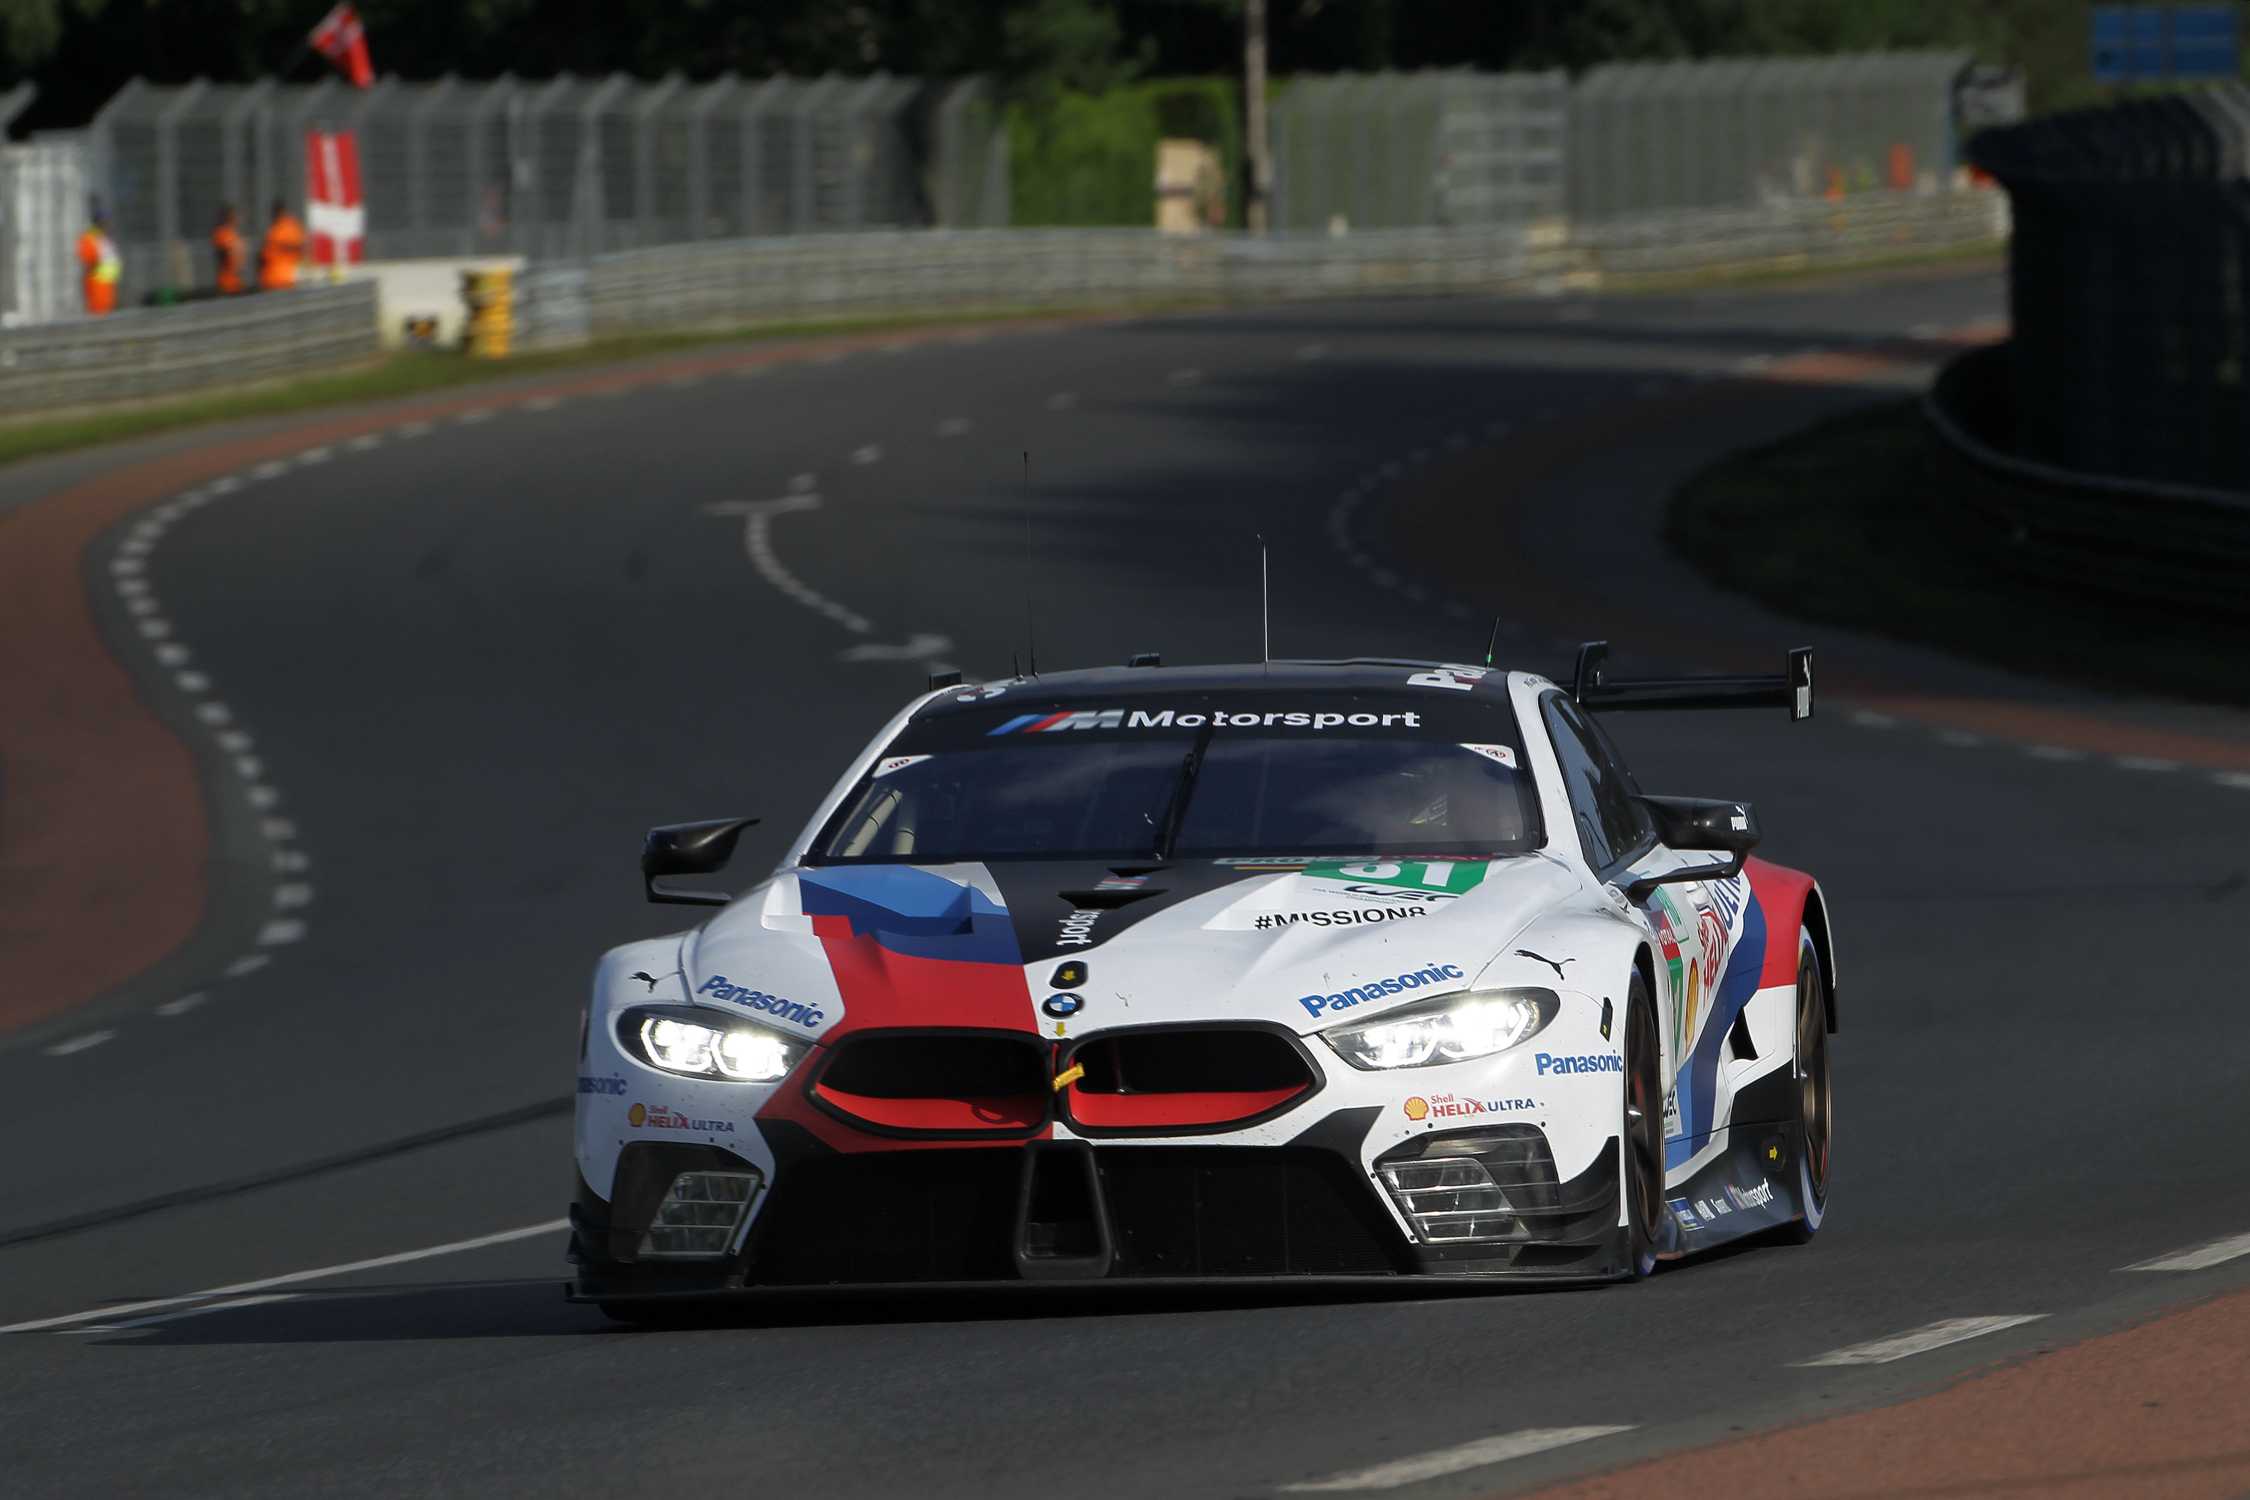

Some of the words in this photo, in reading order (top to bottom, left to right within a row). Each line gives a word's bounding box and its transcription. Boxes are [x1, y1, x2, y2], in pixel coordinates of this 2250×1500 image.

[1127, 711, 1421, 729] Motorsport
[1254, 906, 1427, 931] #MISSION8
[696, 975, 824, 1028] Panasonic
[1298, 963, 1464, 1018] Panasonic
[1535, 1050, 1623, 1076] Panasonic
[1431, 1094, 1454, 1104] Shell
[1432, 1099, 1488, 1118] HELIX
[1487, 1098, 1536, 1112] ULTRA
[648, 1114, 690, 1130] HELIX
[691, 1119, 735, 1133] ULTRA
